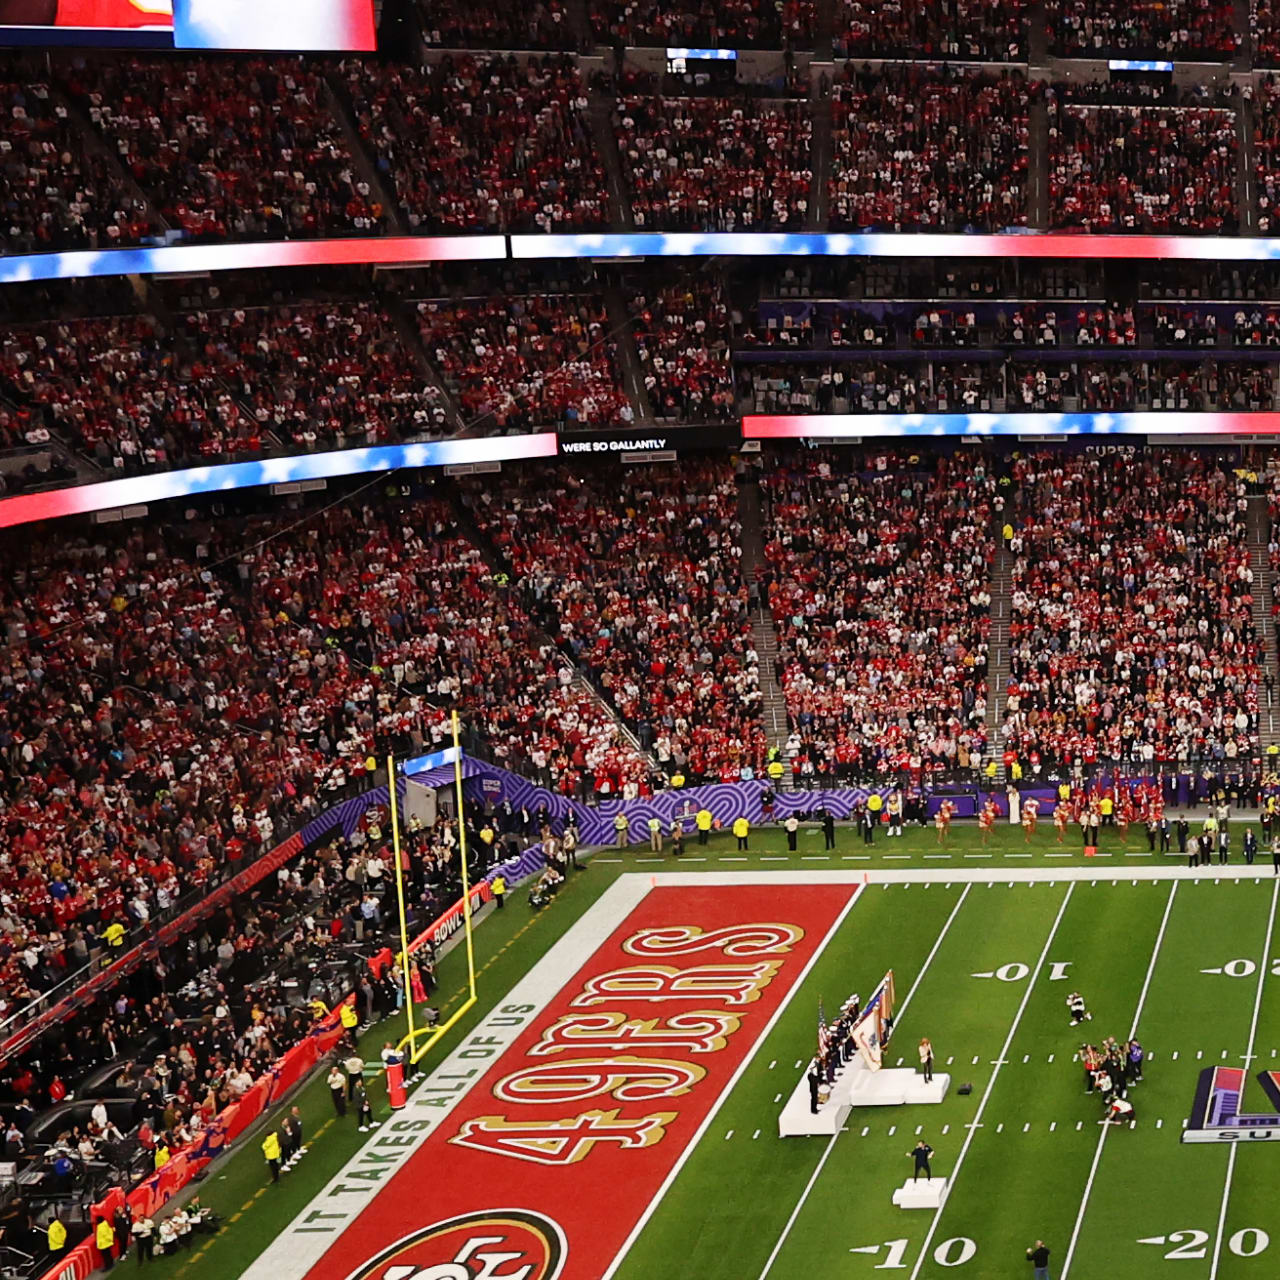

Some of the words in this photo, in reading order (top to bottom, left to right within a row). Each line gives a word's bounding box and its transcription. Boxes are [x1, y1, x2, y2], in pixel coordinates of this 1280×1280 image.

[562, 440, 592, 453] WERE
[593, 440, 608, 452] SO
[609, 438, 666, 451] GALLANTLY
[433, 914, 463, 945] BOWL
[995, 962, 1073, 982] 10
[447, 923, 804, 1165] 49ERS
[292, 1210, 350, 1234] IT
[327, 1119, 430, 1200] TAKES
[419, 1068, 469, 1110] ALL
[468, 1032, 512, 1060] OF
[502, 1002, 536, 1030] US
[873, 1237, 977, 1268] 10
[1163, 1228, 1271, 1260] 20
